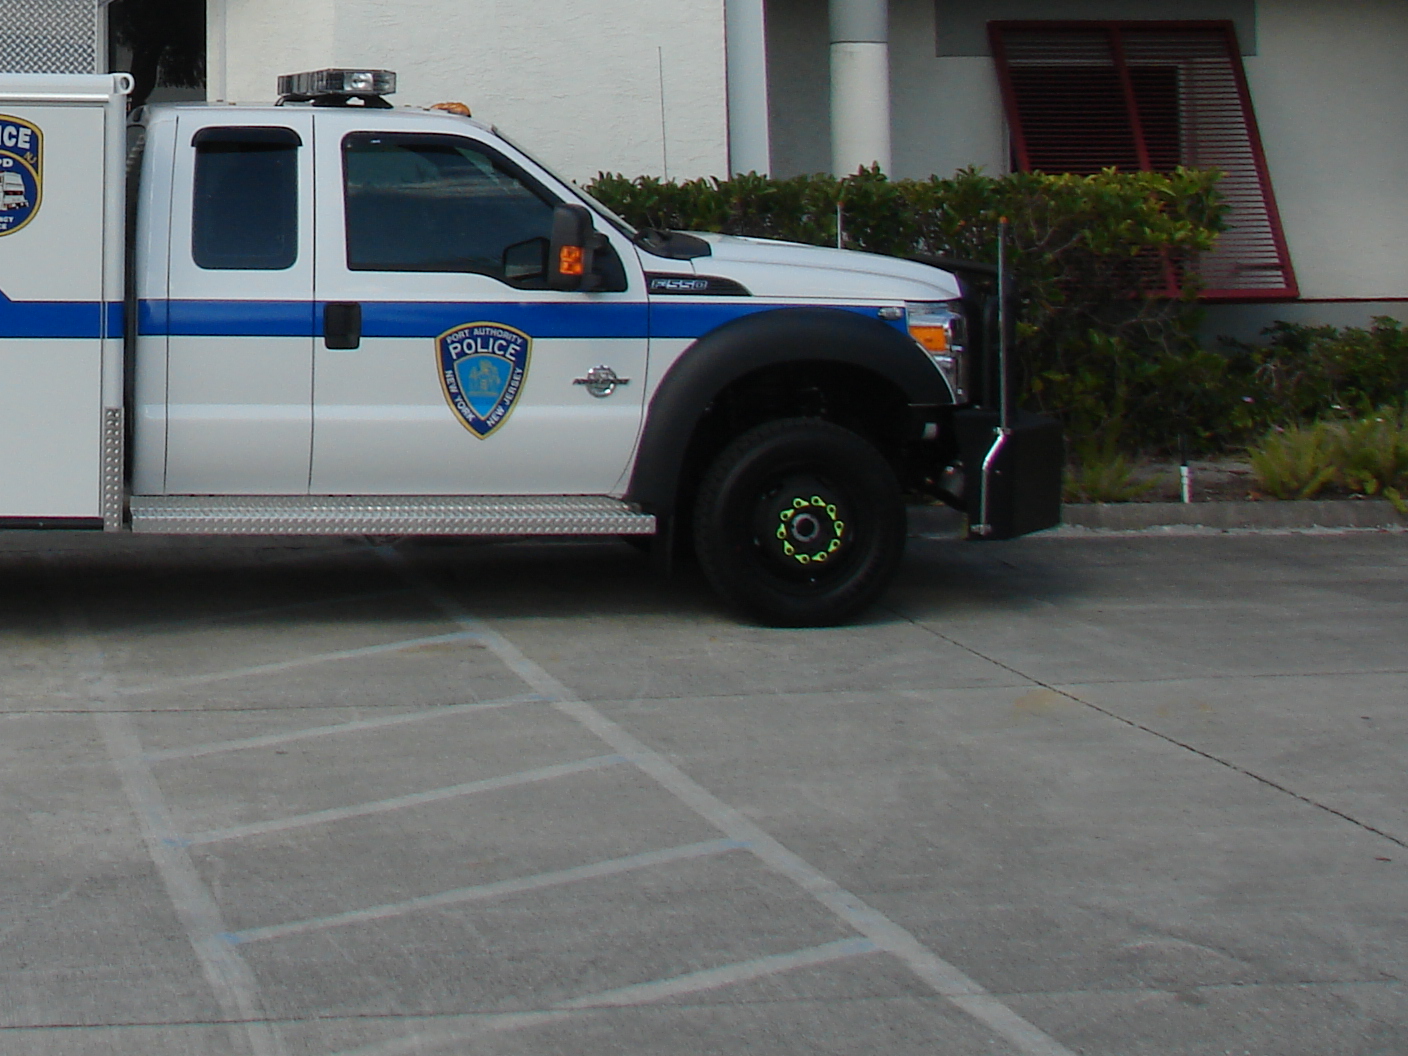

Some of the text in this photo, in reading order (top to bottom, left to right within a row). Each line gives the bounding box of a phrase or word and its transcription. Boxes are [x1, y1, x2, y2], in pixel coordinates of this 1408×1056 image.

[445, 327, 523, 345] PORT AUTHORITY
[448, 337, 521, 361] POLICE
[445, 369, 476, 422] NEW YORK
[486, 405, 505, 427] NEW
